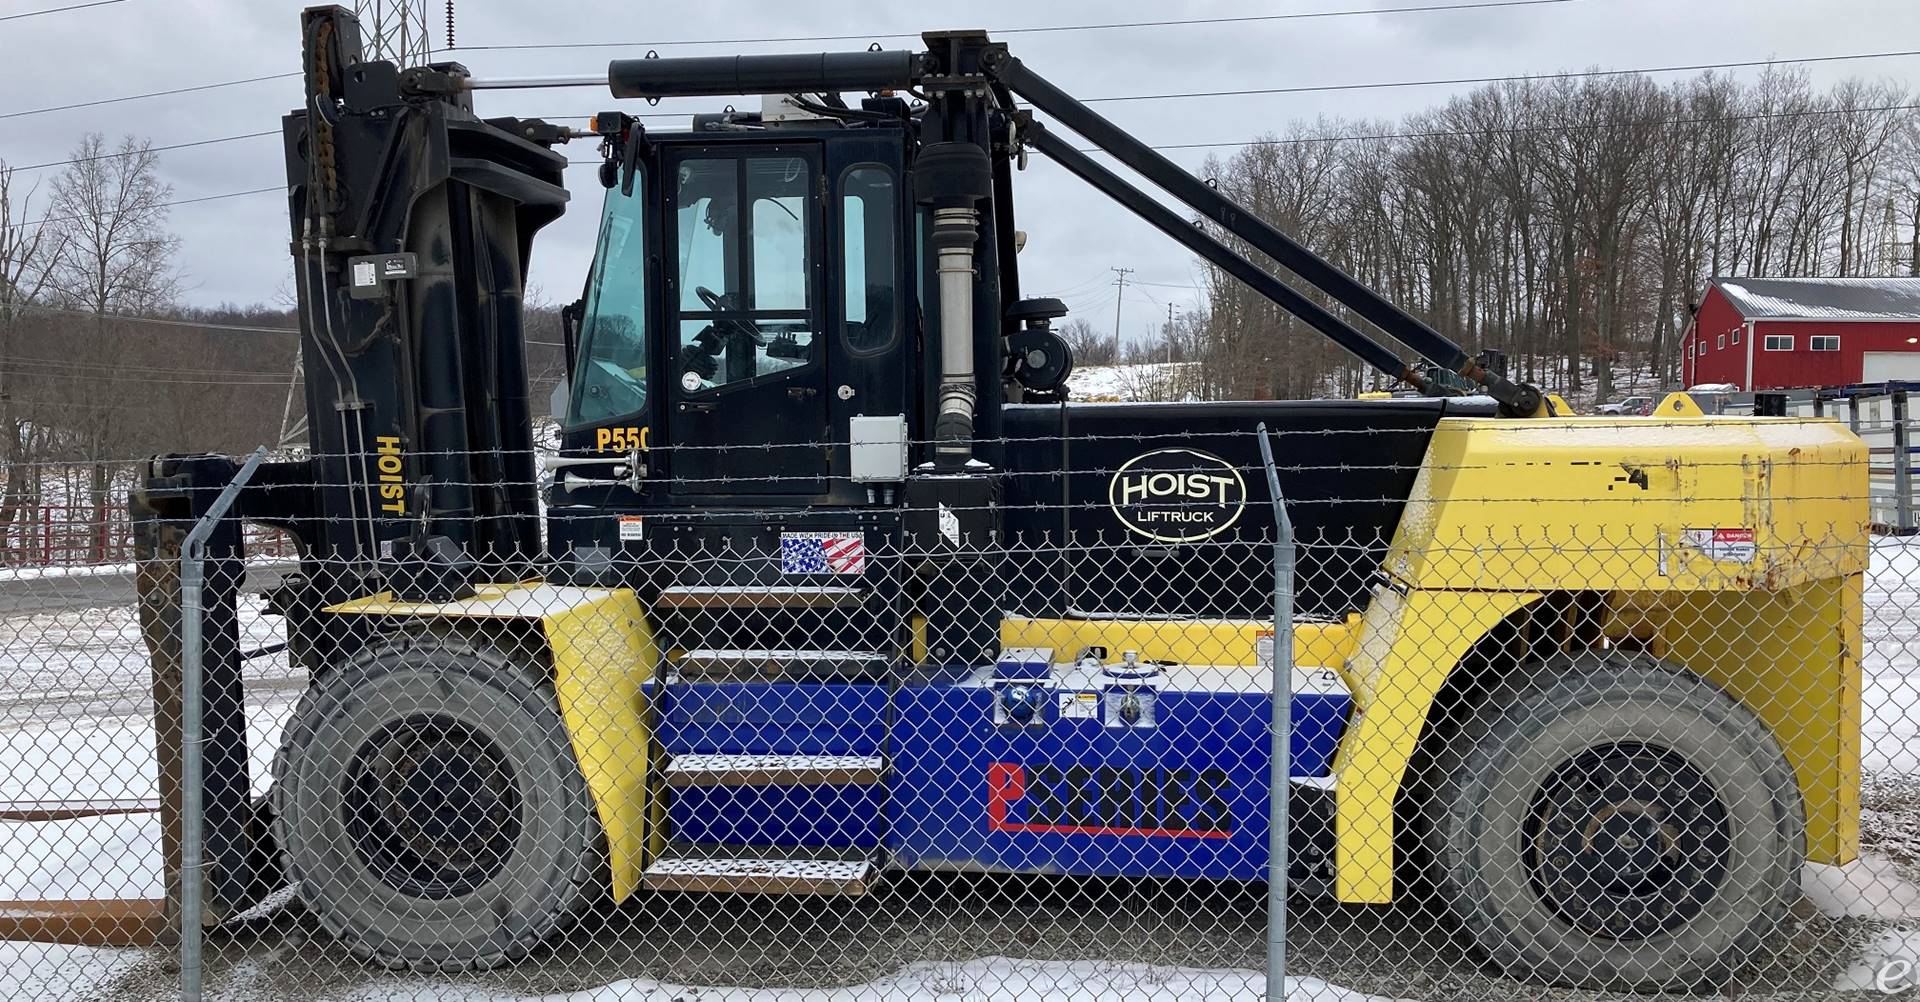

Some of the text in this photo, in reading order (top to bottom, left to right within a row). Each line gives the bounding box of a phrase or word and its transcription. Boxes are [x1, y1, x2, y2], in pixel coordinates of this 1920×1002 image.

[376, 436, 405, 517] HOIST
[1122, 473, 1234, 509] HOIST
[1137, 511, 1215, 523] LIFTRUCK
